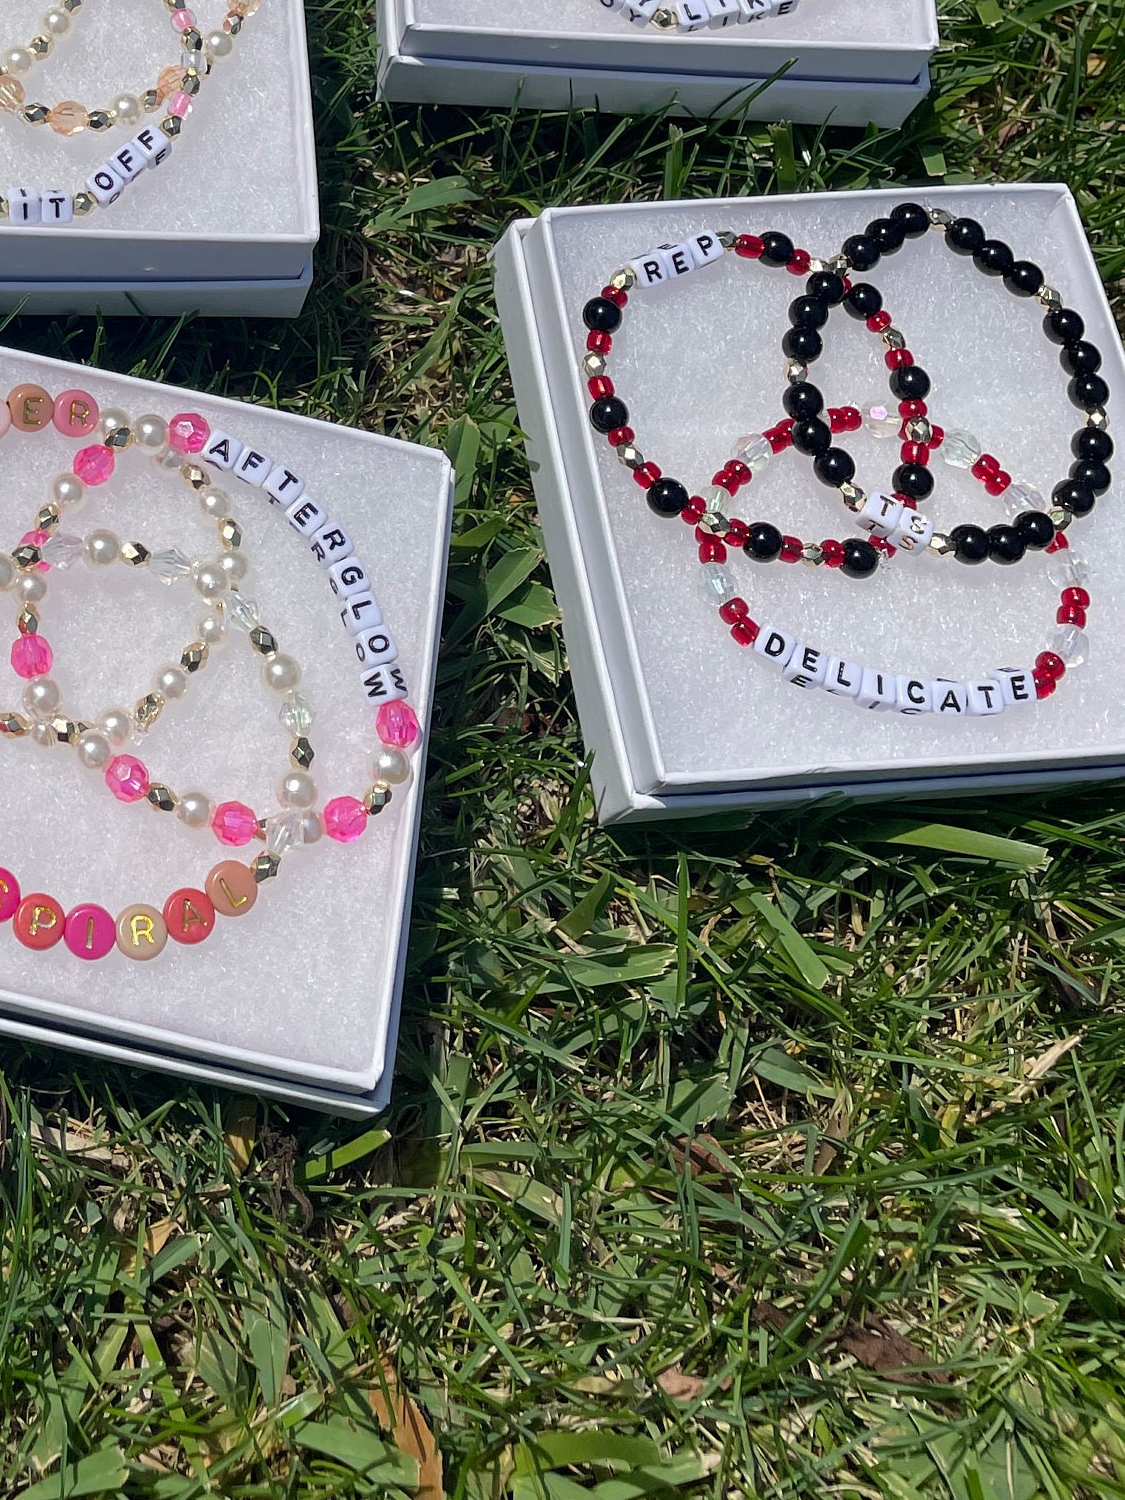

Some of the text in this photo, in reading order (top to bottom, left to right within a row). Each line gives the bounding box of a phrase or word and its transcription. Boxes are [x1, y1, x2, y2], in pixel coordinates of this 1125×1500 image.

[95, 128, 168, 192] OFF
[643, 234, 716, 283] REP
[866, 494, 928, 551] TS
[207, 437, 413, 700] AFTERGLOW
[763, 630, 1037, 714] DELICATE
